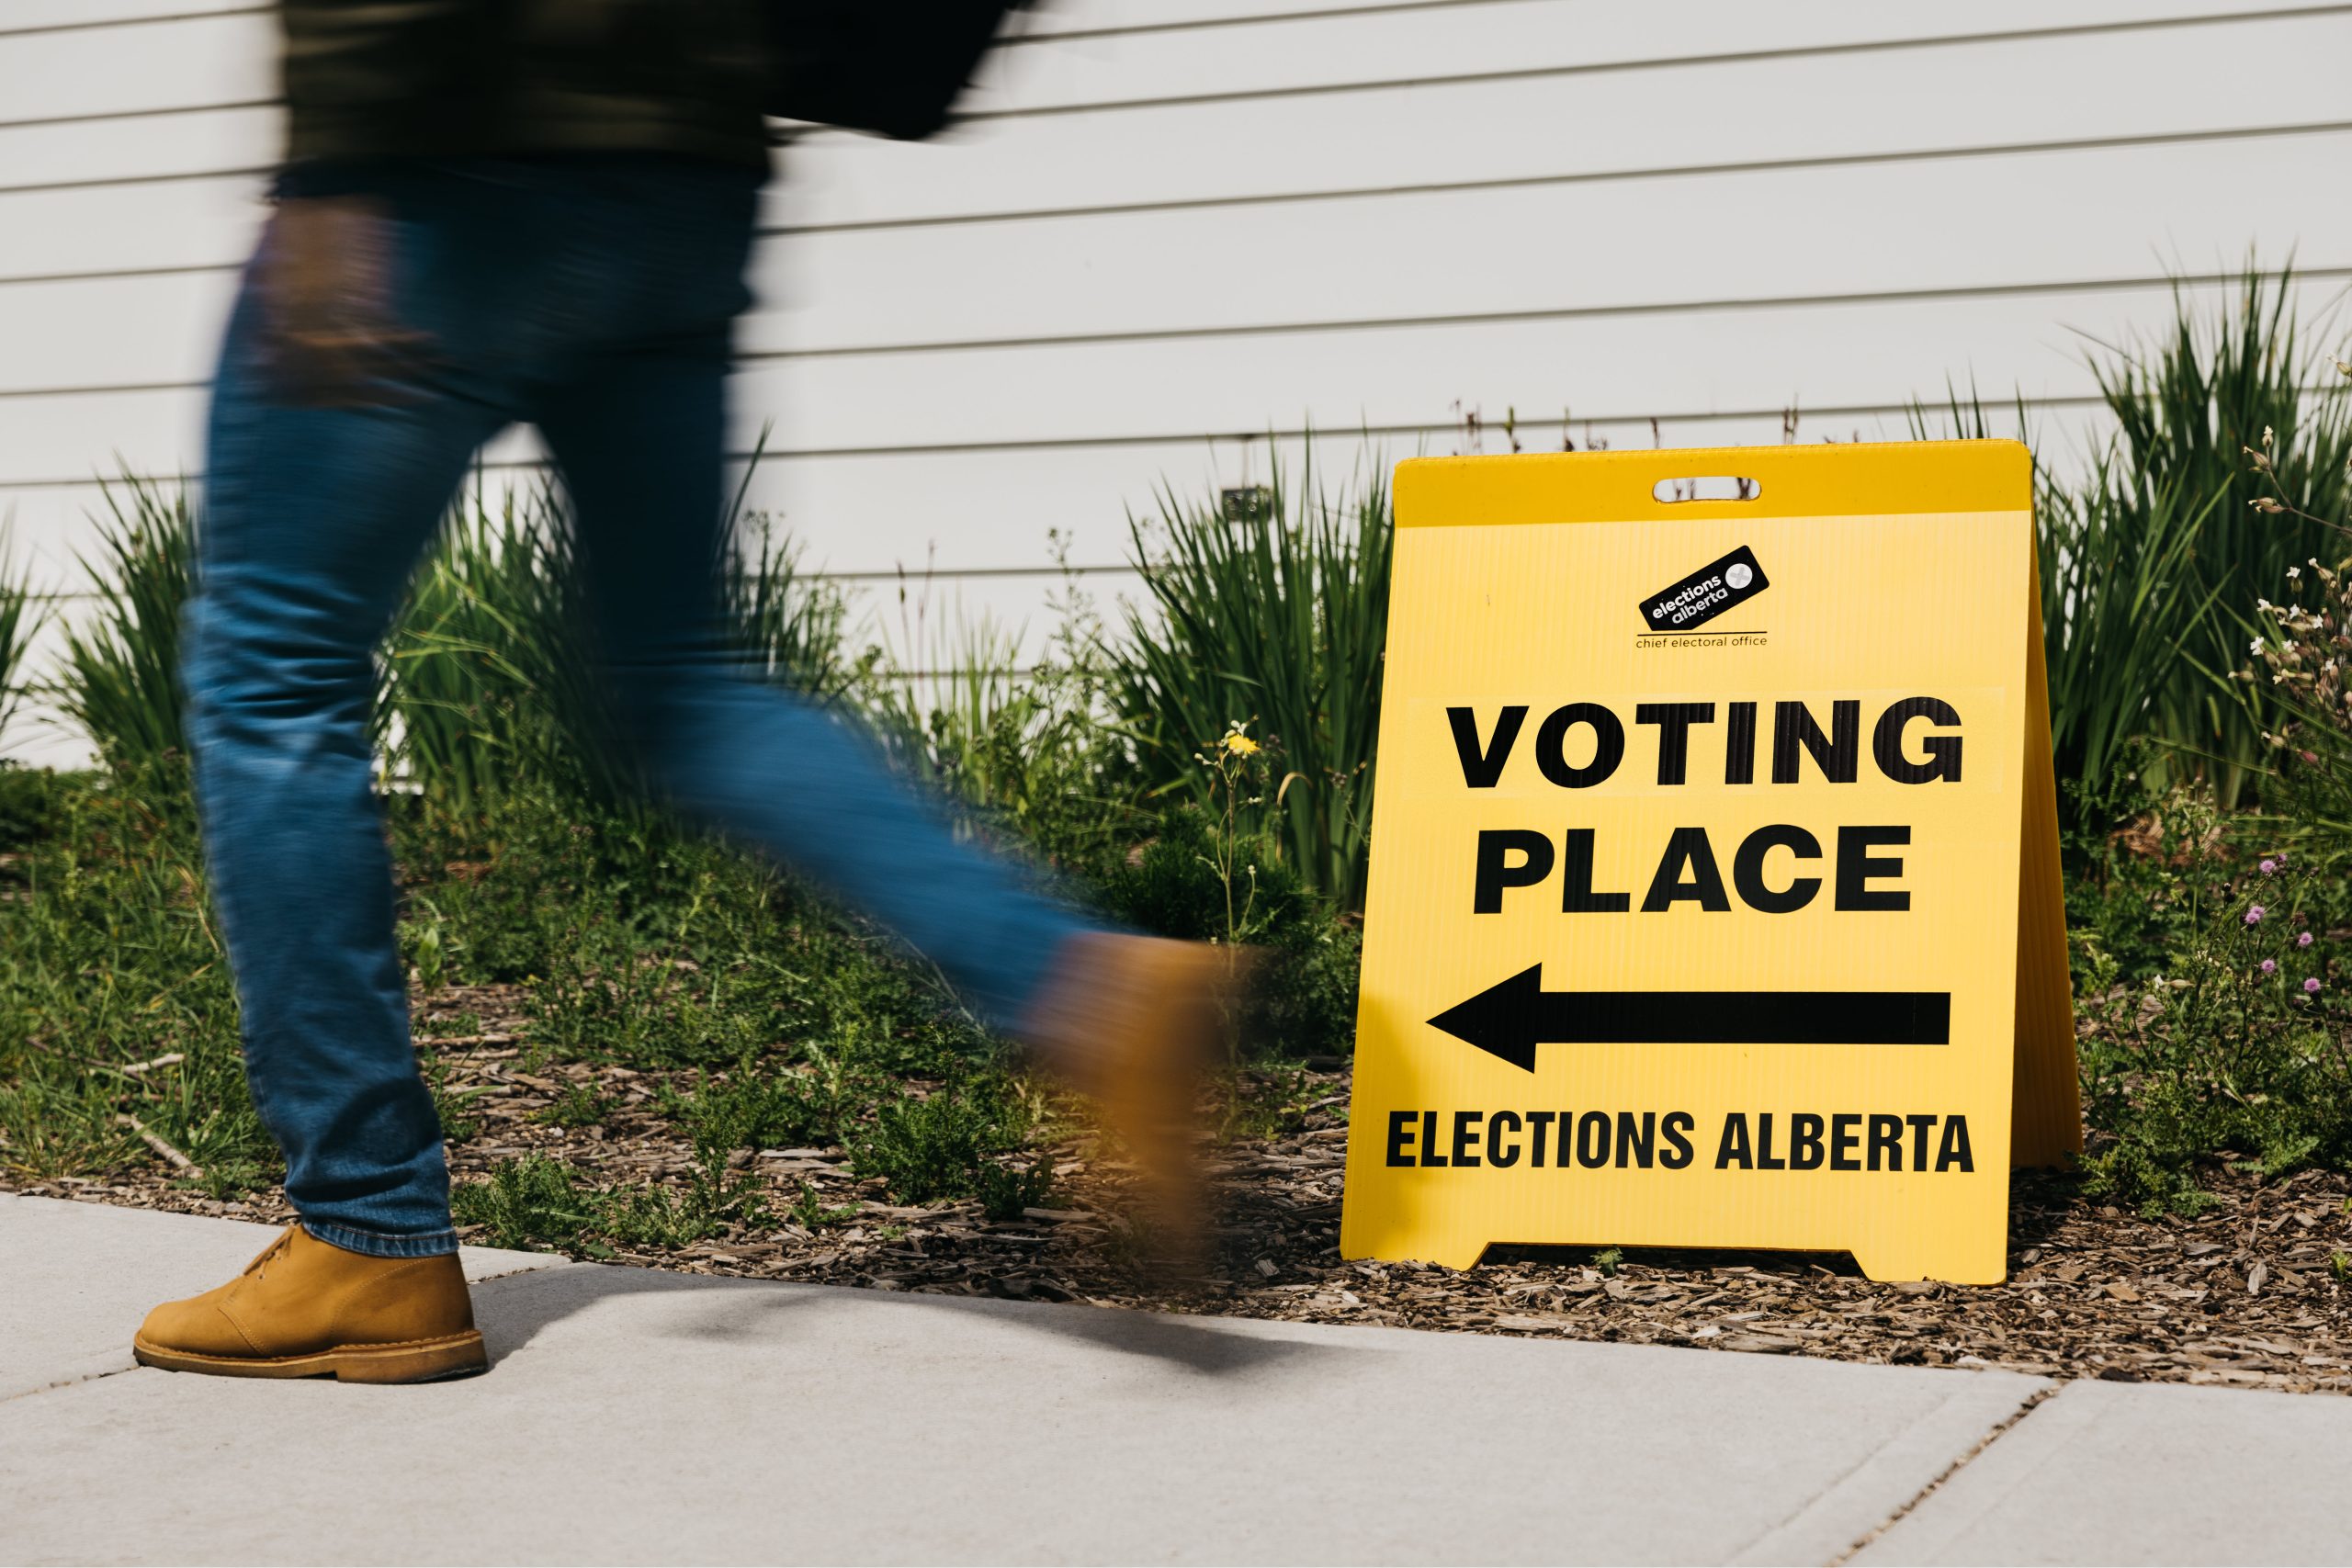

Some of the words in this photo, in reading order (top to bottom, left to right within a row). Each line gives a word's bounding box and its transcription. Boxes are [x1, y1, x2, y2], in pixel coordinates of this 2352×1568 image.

[1653, 575, 1722, 619] elections
[1671, 587, 1729, 624] alberta
[1635, 637, 1668, 649] chief
[1671, 637, 1727, 648] electoral
[1731, 636, 1768, 646] office
[1446, 696, 1963, 789] VOTING
[1473, 824, 1911, 915] PLACE
[1385, 1110, 1694, 1170] ELECTIONS
[1714, 1112, 1975, 1174] ALBERTA
